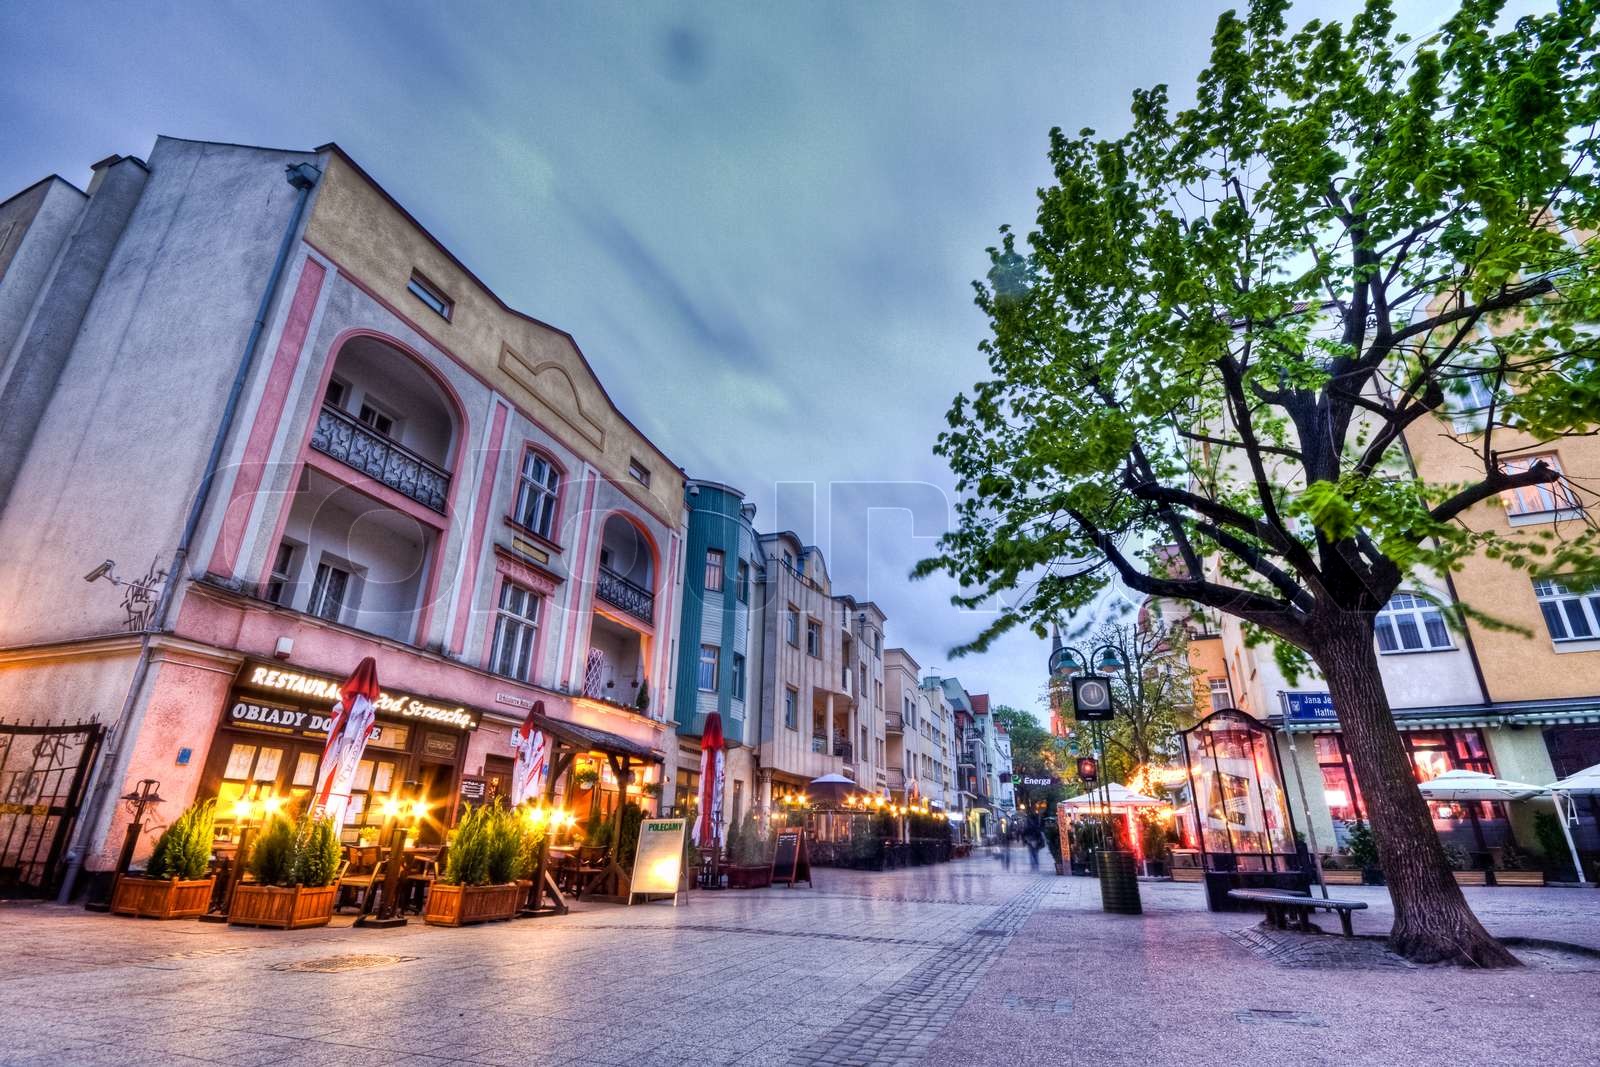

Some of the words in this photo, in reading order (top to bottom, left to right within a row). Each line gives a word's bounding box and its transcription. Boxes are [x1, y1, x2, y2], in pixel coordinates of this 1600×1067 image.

[251, 667, 343, 700] RESTAURAC
[1304, 695, 1321, 704] Jana
[1323, 695, 1332, 704] Je
[232, 703, 307, 726] OBIADY
[1314, 708, 1337, 717] Haffn
[1024, 777, 1051, 786] Energa
[648, 823, 683, 831] POLECAMY
